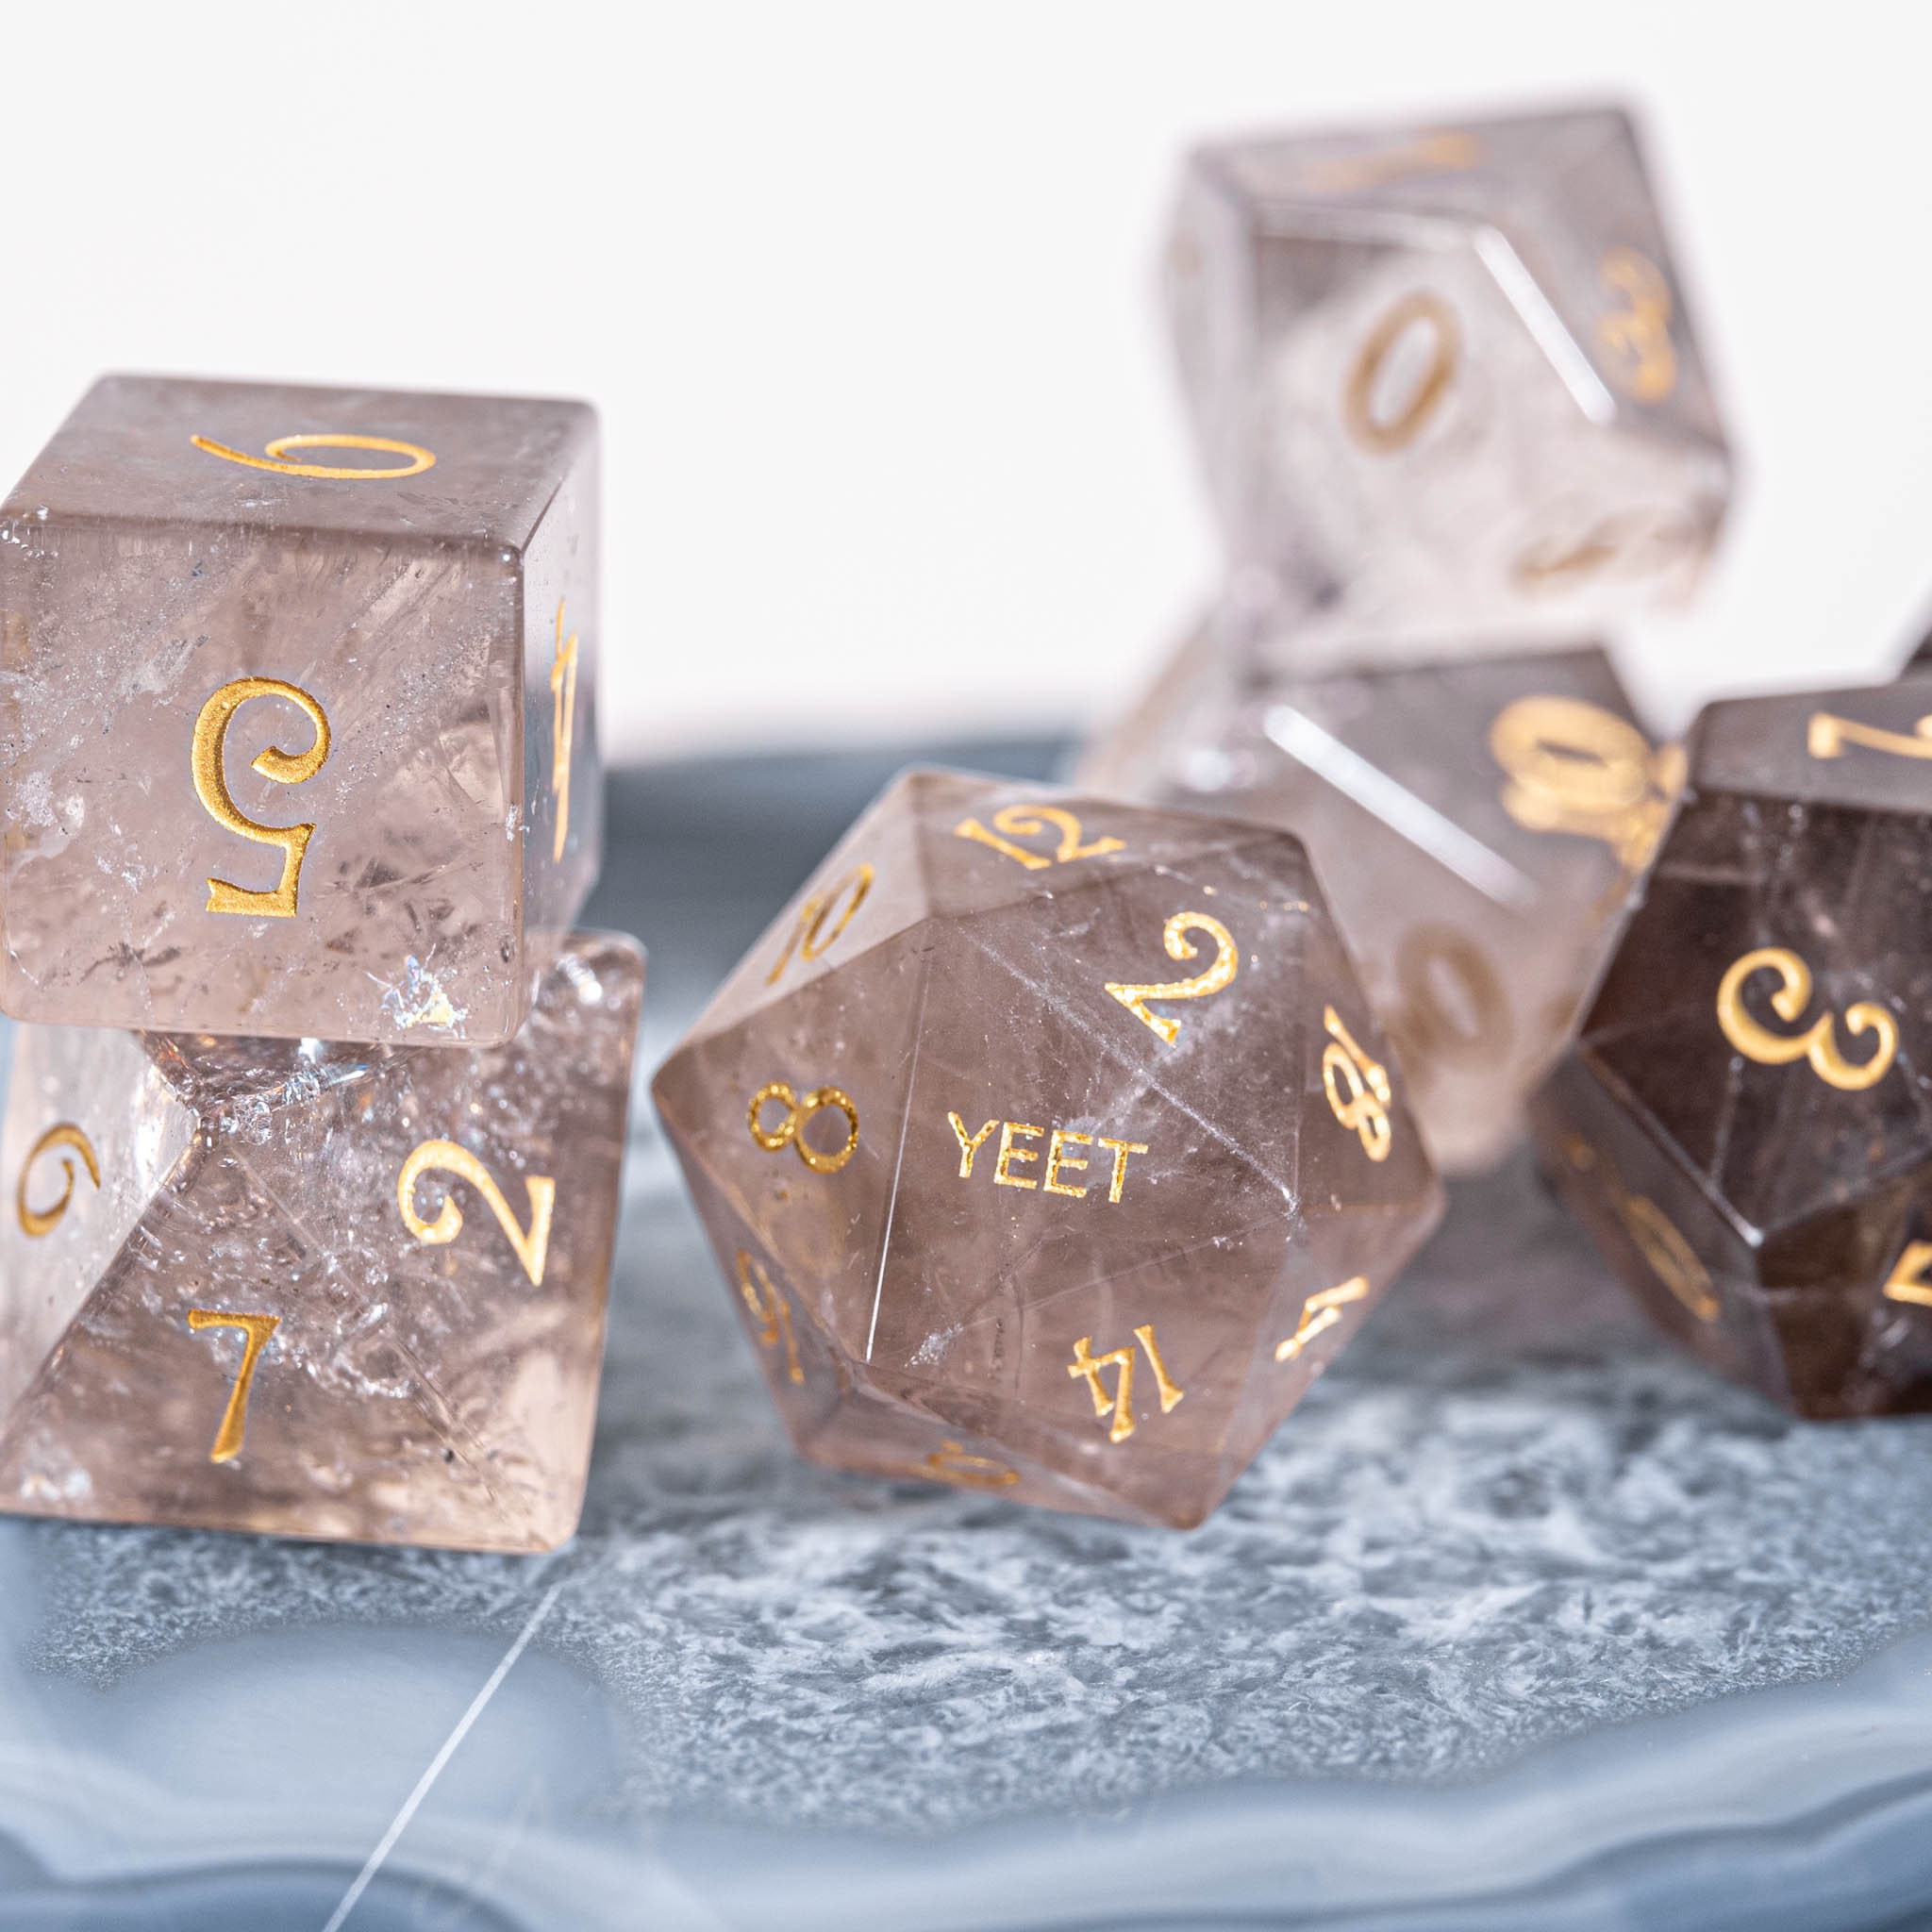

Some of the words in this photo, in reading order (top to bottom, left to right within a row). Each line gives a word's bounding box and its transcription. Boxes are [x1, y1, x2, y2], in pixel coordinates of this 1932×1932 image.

[1341, 291, 1462, 457] 0
[192, 434, 436, 480] 6
[192, 676, 331, 918] 5
[954, 805, 1126, 870] 12
[765, 862, 875, 988] 10
[1104, 911, 1239, 1043] 2
[1323, 1005, 1391, 1162] 18
[1717, 947, 1898, 1091] 3
[748, 1080, 859, 1174] 8
[947, 1111, 1149, 1204] YEET
[397, 1140, 555, 1286] 2
[189, 1308, 281, 1463] 7
[1067, 1324, 1186, 1444] 14
